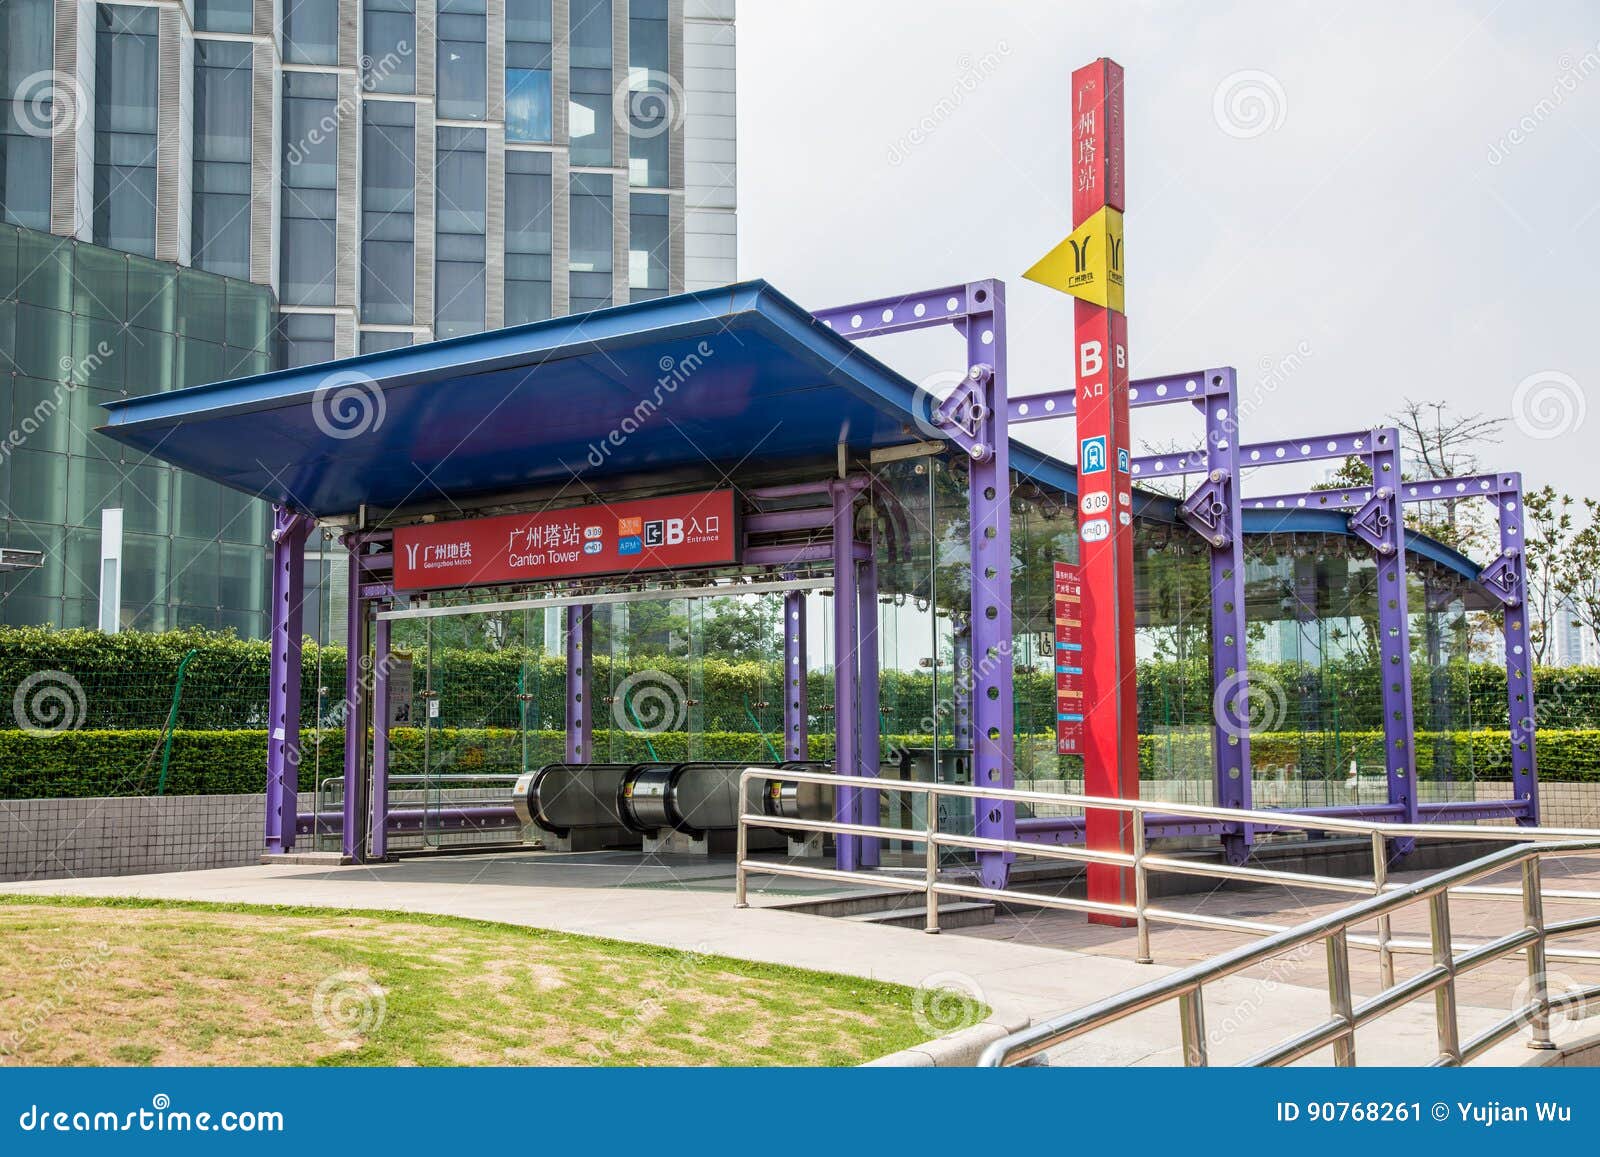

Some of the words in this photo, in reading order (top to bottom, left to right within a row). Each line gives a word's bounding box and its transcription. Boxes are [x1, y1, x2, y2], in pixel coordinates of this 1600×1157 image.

[1078, 79, 1097, 193] 广州塔站
[1081, 340, 1103, 378] B
[1116, 344, 1125, 369] B
[1082, 383, 1103, 400] 入口
[666, 518, 684, 545] B
[687, 516, 719, 535] 入口
[509, 522, 581, 552] 广州塔站
[687, 535, 719, 543] Entrance
[424, 541, 472, 561] 广州地铁
[509, 553, 546, 568] Canton
[547, 549, 581, 564] Tower
